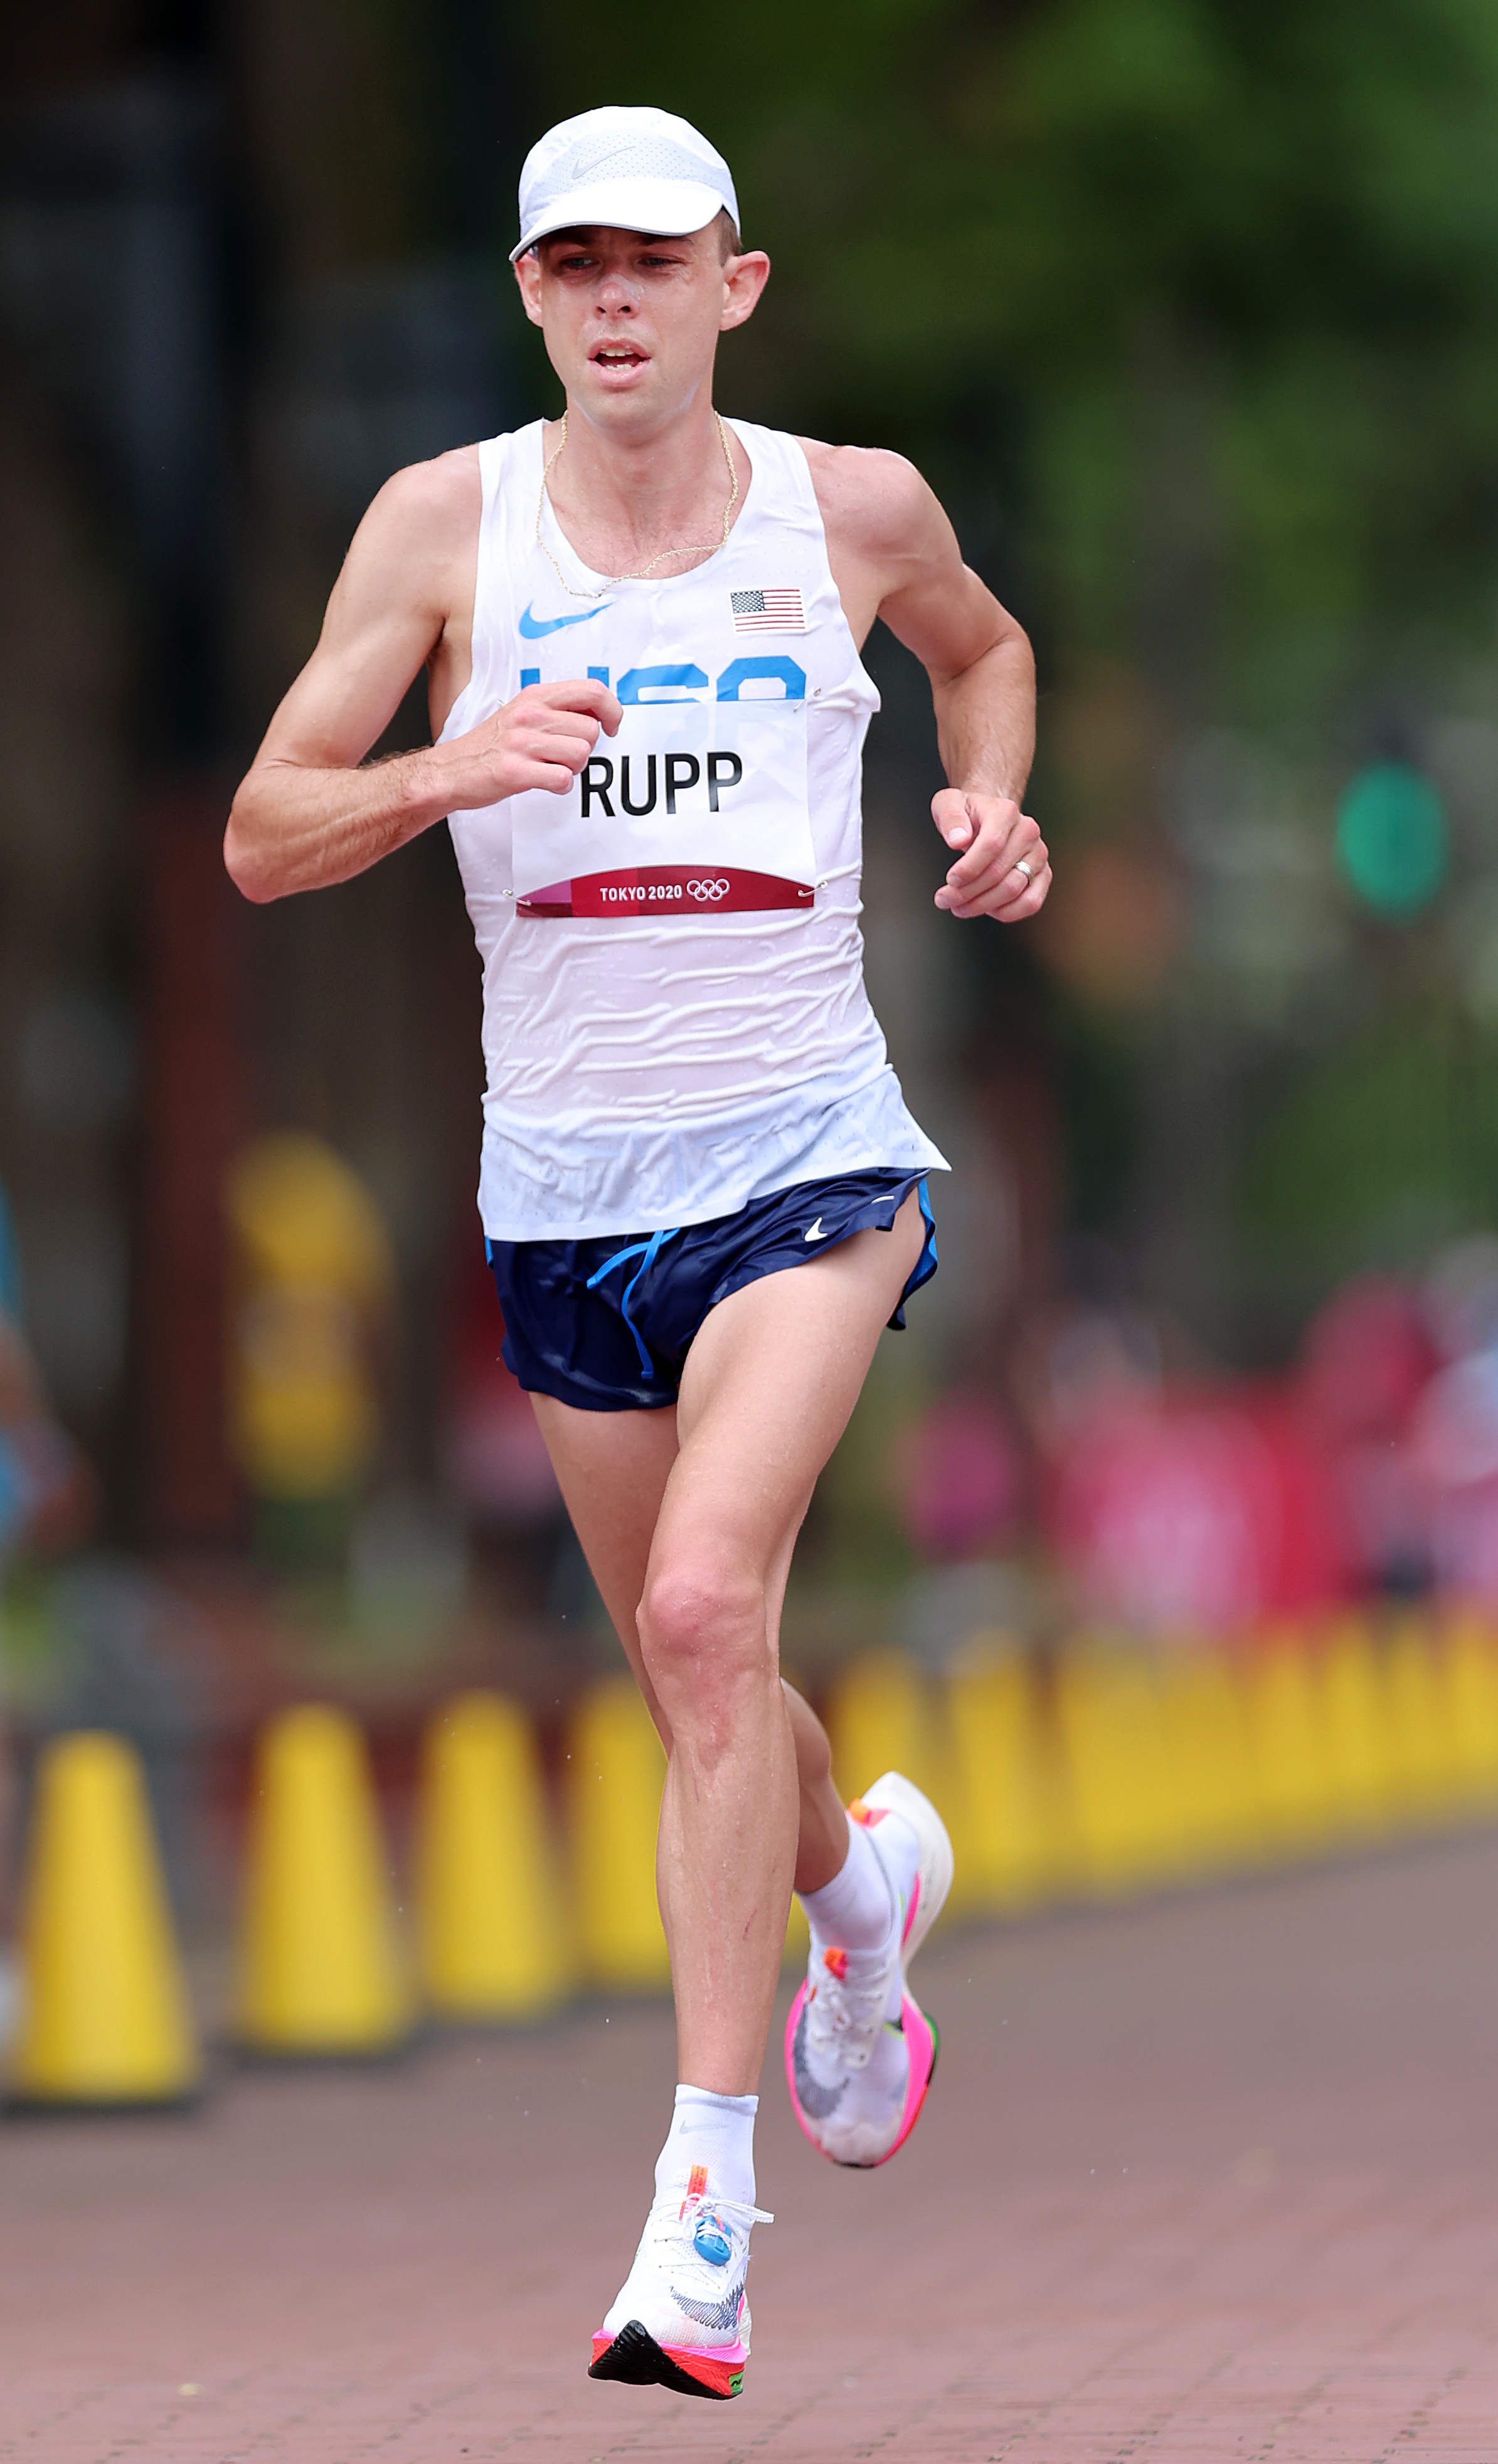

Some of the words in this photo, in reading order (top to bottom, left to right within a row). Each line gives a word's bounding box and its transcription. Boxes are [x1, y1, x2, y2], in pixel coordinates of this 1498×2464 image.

[580, 751, 743, 817] RUPP
[600, 886, 646, 902] TOKYO
[648, 884, 683, 901] 2020
